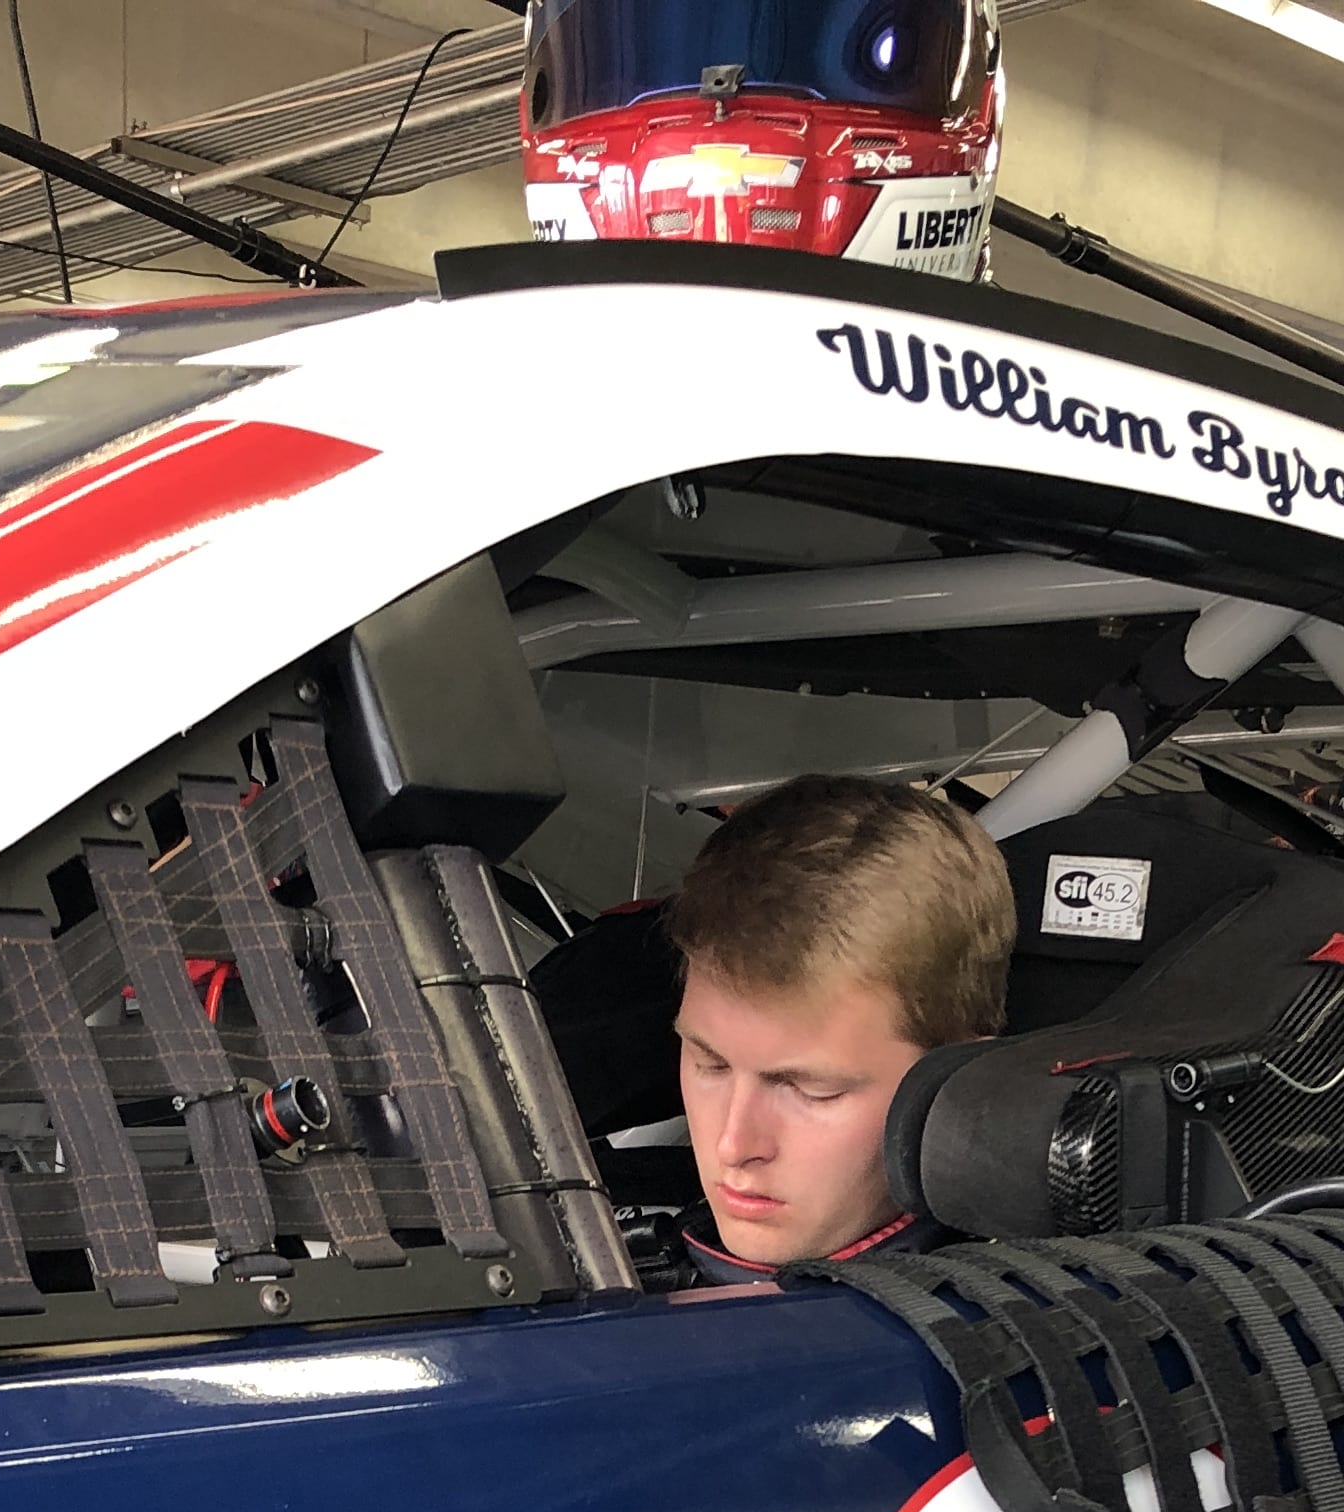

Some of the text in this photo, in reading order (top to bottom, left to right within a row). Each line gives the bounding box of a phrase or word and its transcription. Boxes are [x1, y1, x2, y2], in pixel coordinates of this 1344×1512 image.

[816, 323, 1176, 459] William
[1058, 876, 1133, 904] sfi 45.2
